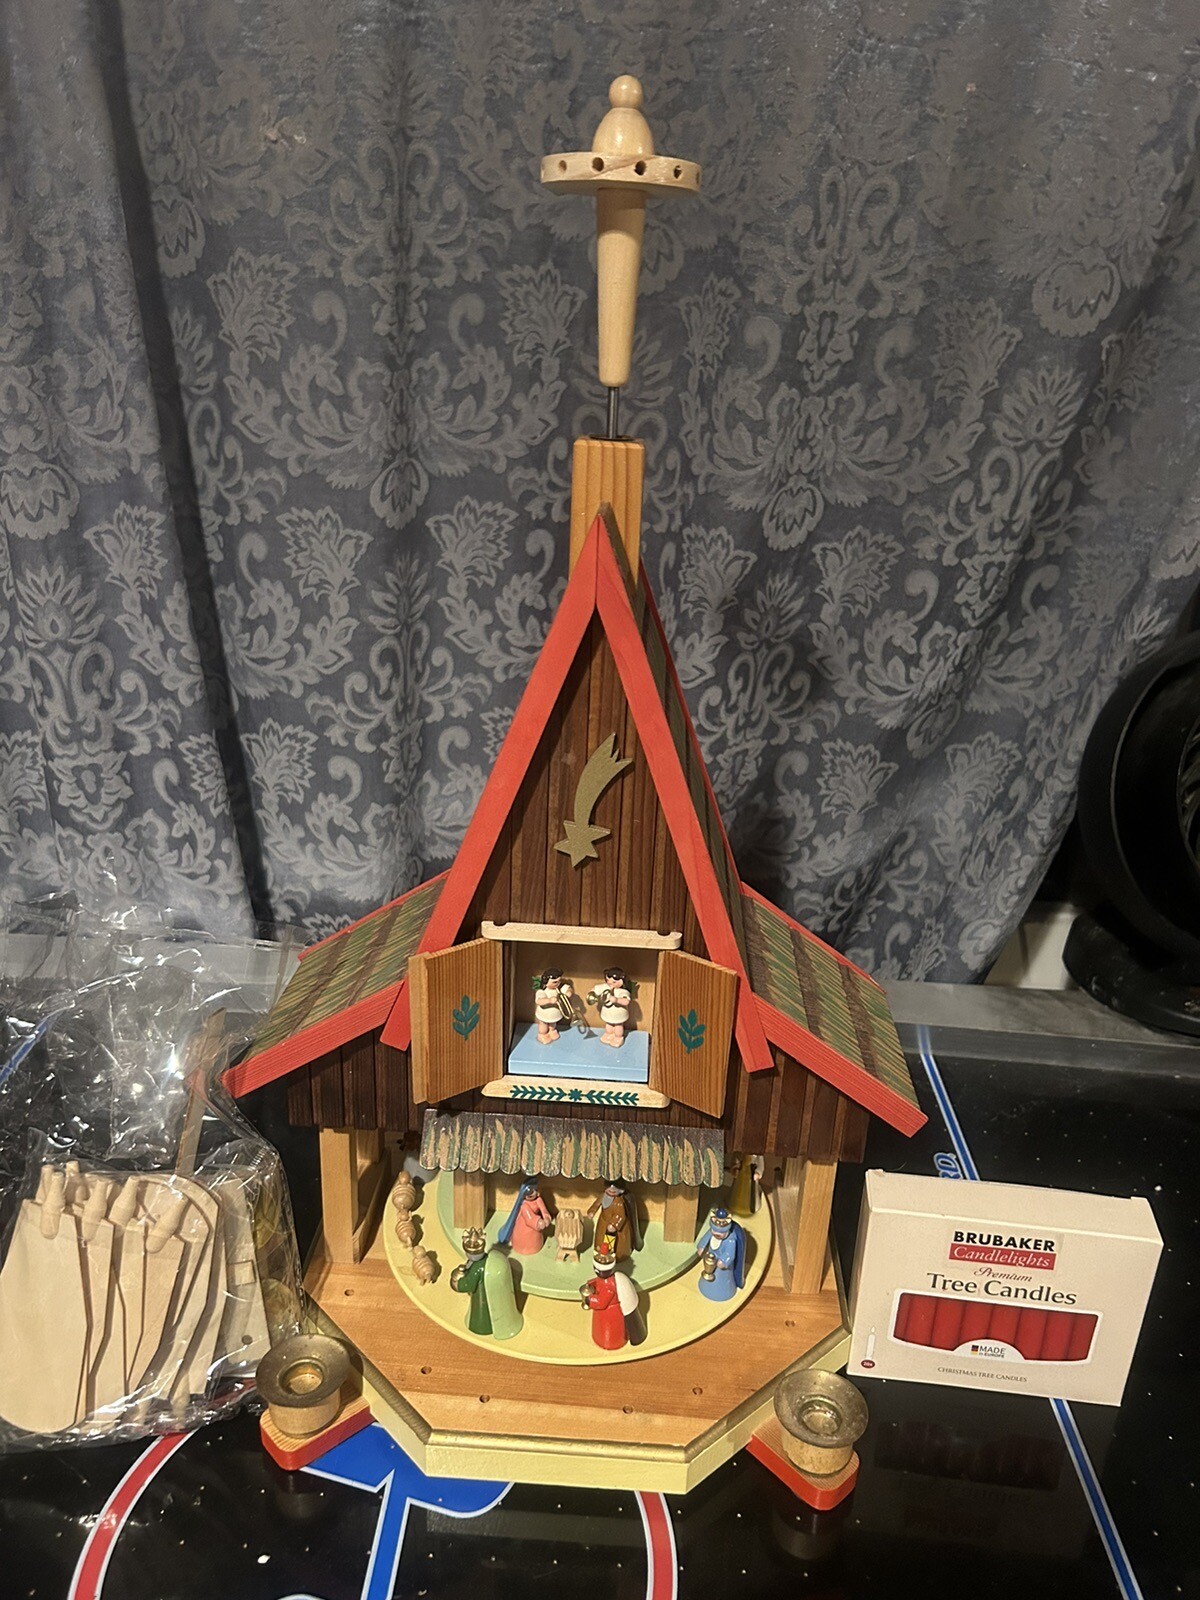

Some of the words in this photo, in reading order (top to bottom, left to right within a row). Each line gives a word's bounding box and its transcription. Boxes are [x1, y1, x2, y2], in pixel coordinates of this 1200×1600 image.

[953, 1231, 1055, 1251] BRUBAKER
[953, 1246, 1051, 1268] Candlelights
[974, 1267, 1032, 1282] Premium
[927, 1272, 978, 1293] Tree
[983, 1279, 1077, 1305] Candles
[980, 1346, 1006, 1354] MADE
[938, 1367, 977, 1377] CHRISTMAS
[996, 1374, 1028, 1382] CANDLES
